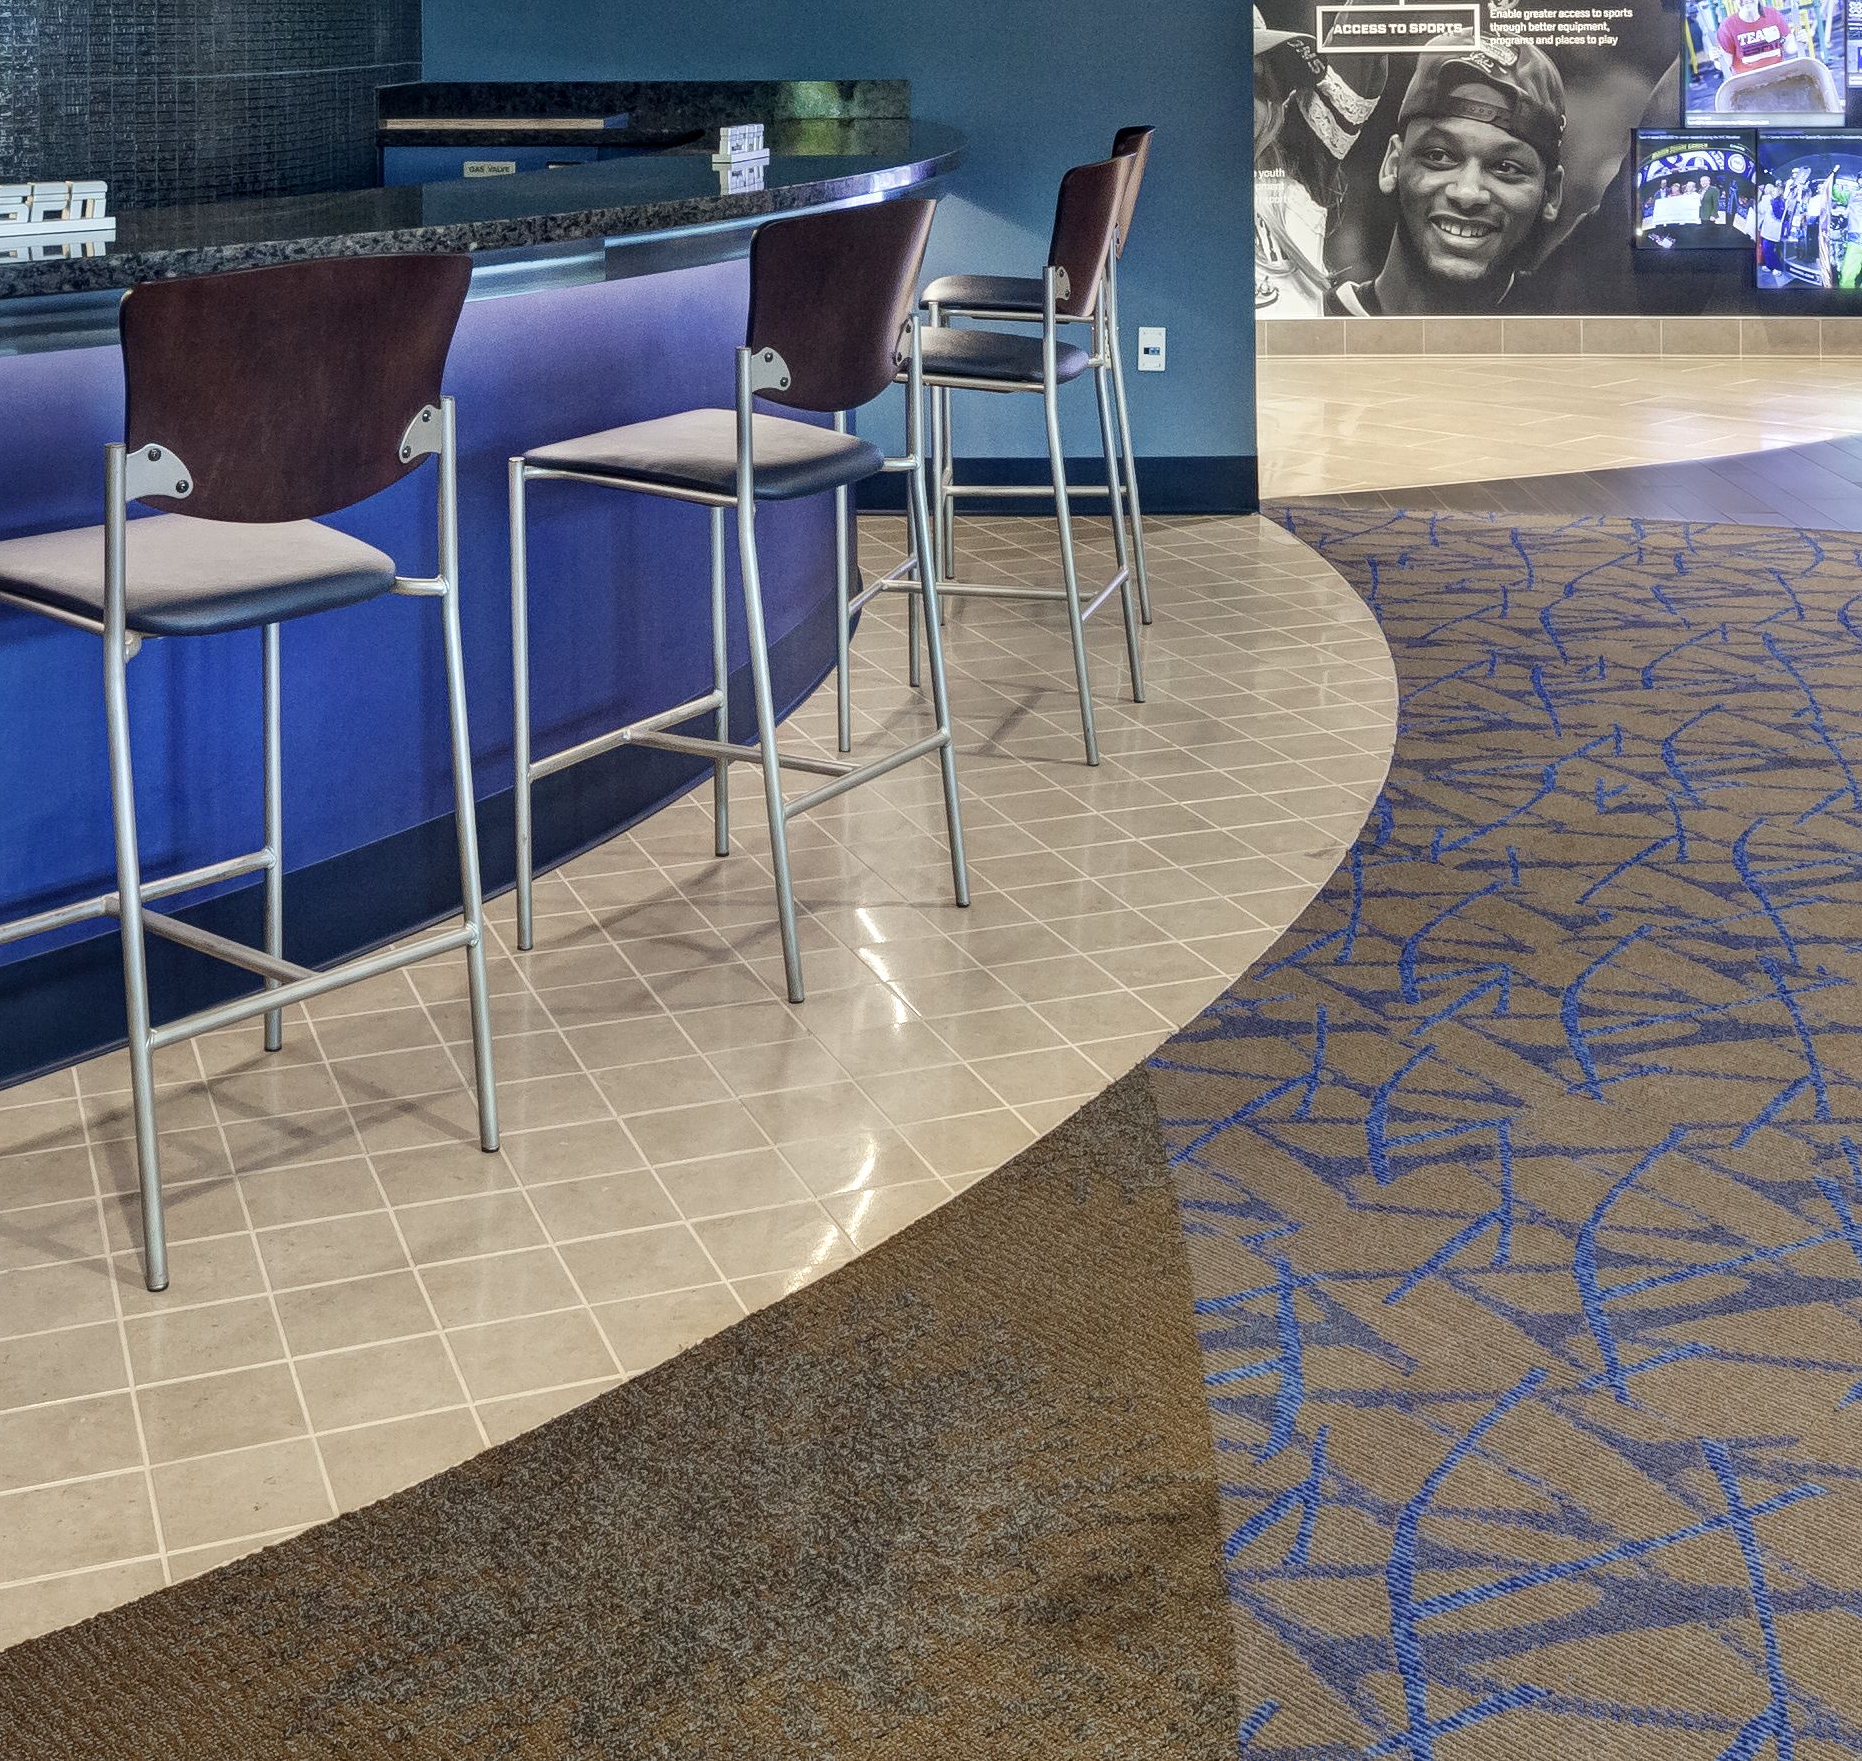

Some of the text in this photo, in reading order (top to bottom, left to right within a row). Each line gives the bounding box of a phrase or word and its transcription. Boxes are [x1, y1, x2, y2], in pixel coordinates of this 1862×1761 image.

[1490, 8, 1634, 20] Enable greater access to sports
[1333, 23, 1463, 34] ACCESS TO SPORTS
[1490, 22, 1610, 33] through better equipment,
[1489, 35, 1619, 47] programs and places to play
[1737, 26, 1781, 46] TEA
[468, 165, 511, 174] GAS VALVE
[1258, 168, 1285, 180] youth
